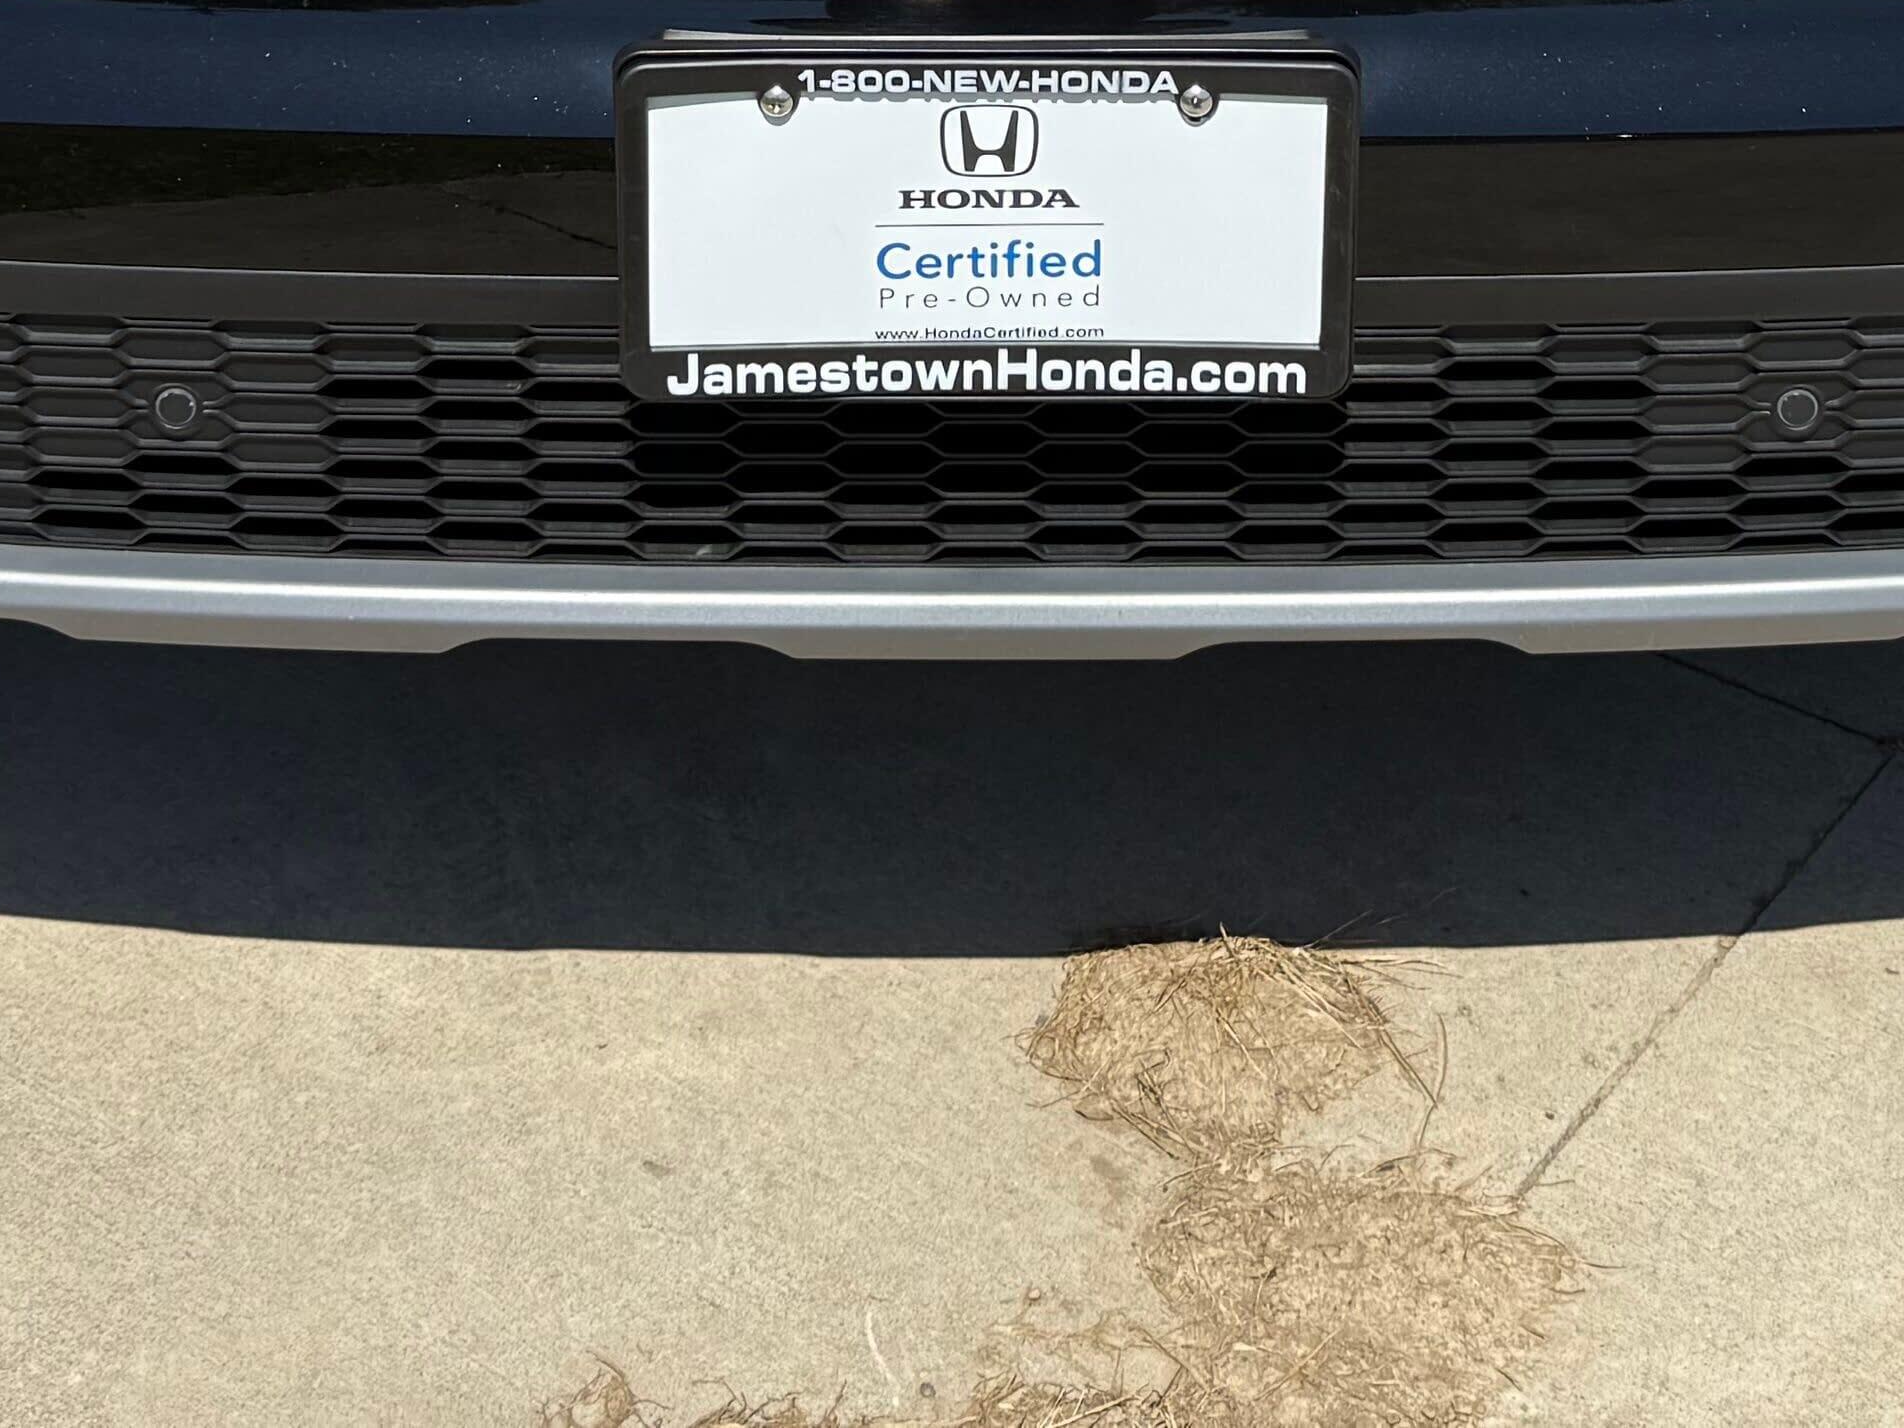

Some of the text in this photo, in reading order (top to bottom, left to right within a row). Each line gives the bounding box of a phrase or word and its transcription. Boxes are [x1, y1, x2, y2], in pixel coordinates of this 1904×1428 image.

[796, 69, 1179, 96] 1-800-NEW-HONDA
[897, 188, 1080, 210] HONDA
[875, 239, 1102, 280] Certified
[879, 283, 1100, 309] Pre-Owned
[874, 326, 1105, 340] www.HondaCertified.com
[667, 349, 1307, 395] JamestownHonda.com
